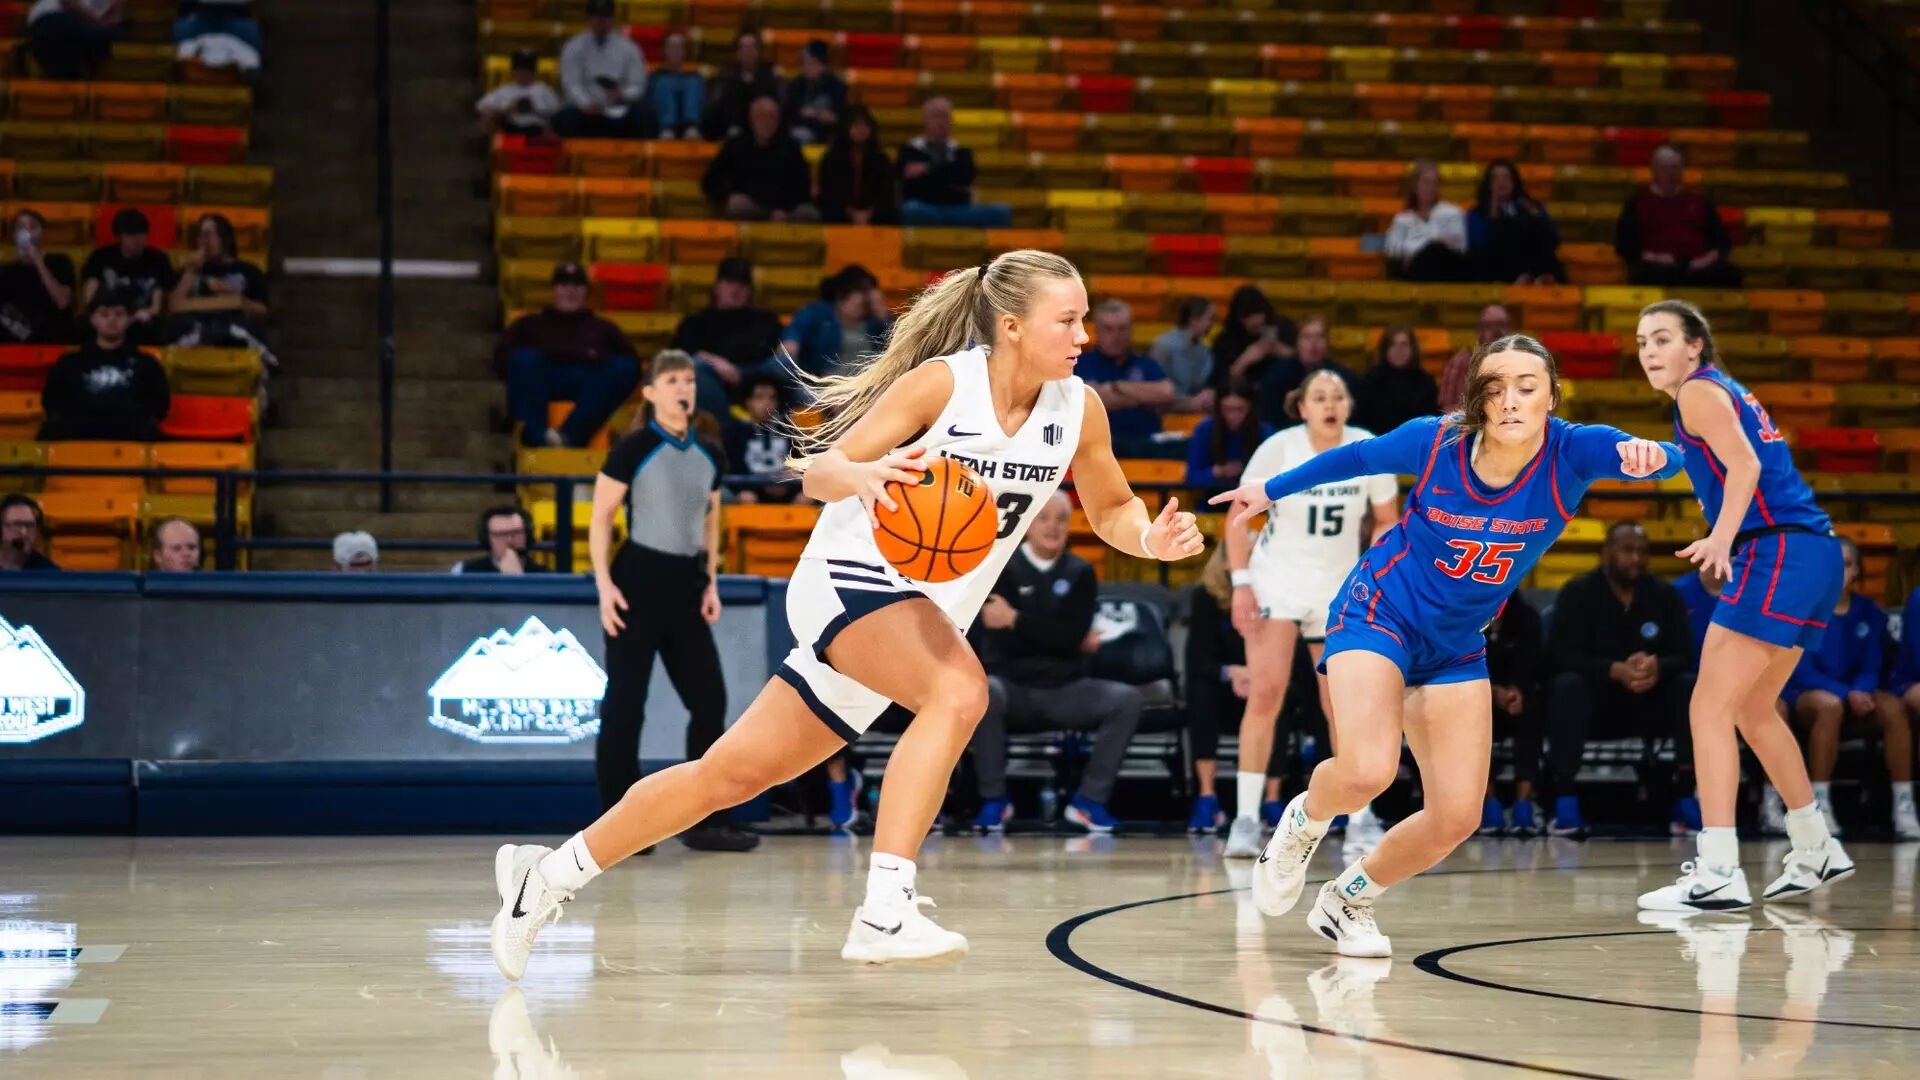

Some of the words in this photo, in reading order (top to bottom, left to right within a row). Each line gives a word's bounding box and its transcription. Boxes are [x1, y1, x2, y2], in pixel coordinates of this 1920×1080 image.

[940, 450, 998, 478] TAH
[1002, 462, 1059, 482] STATE
[1308, 504, 1345, 536] 15
[1427, 506, 1489, 532] BOISE
[1489, 518, 1548, 535] STATE
[1434, 538, 1526, 584] 35
